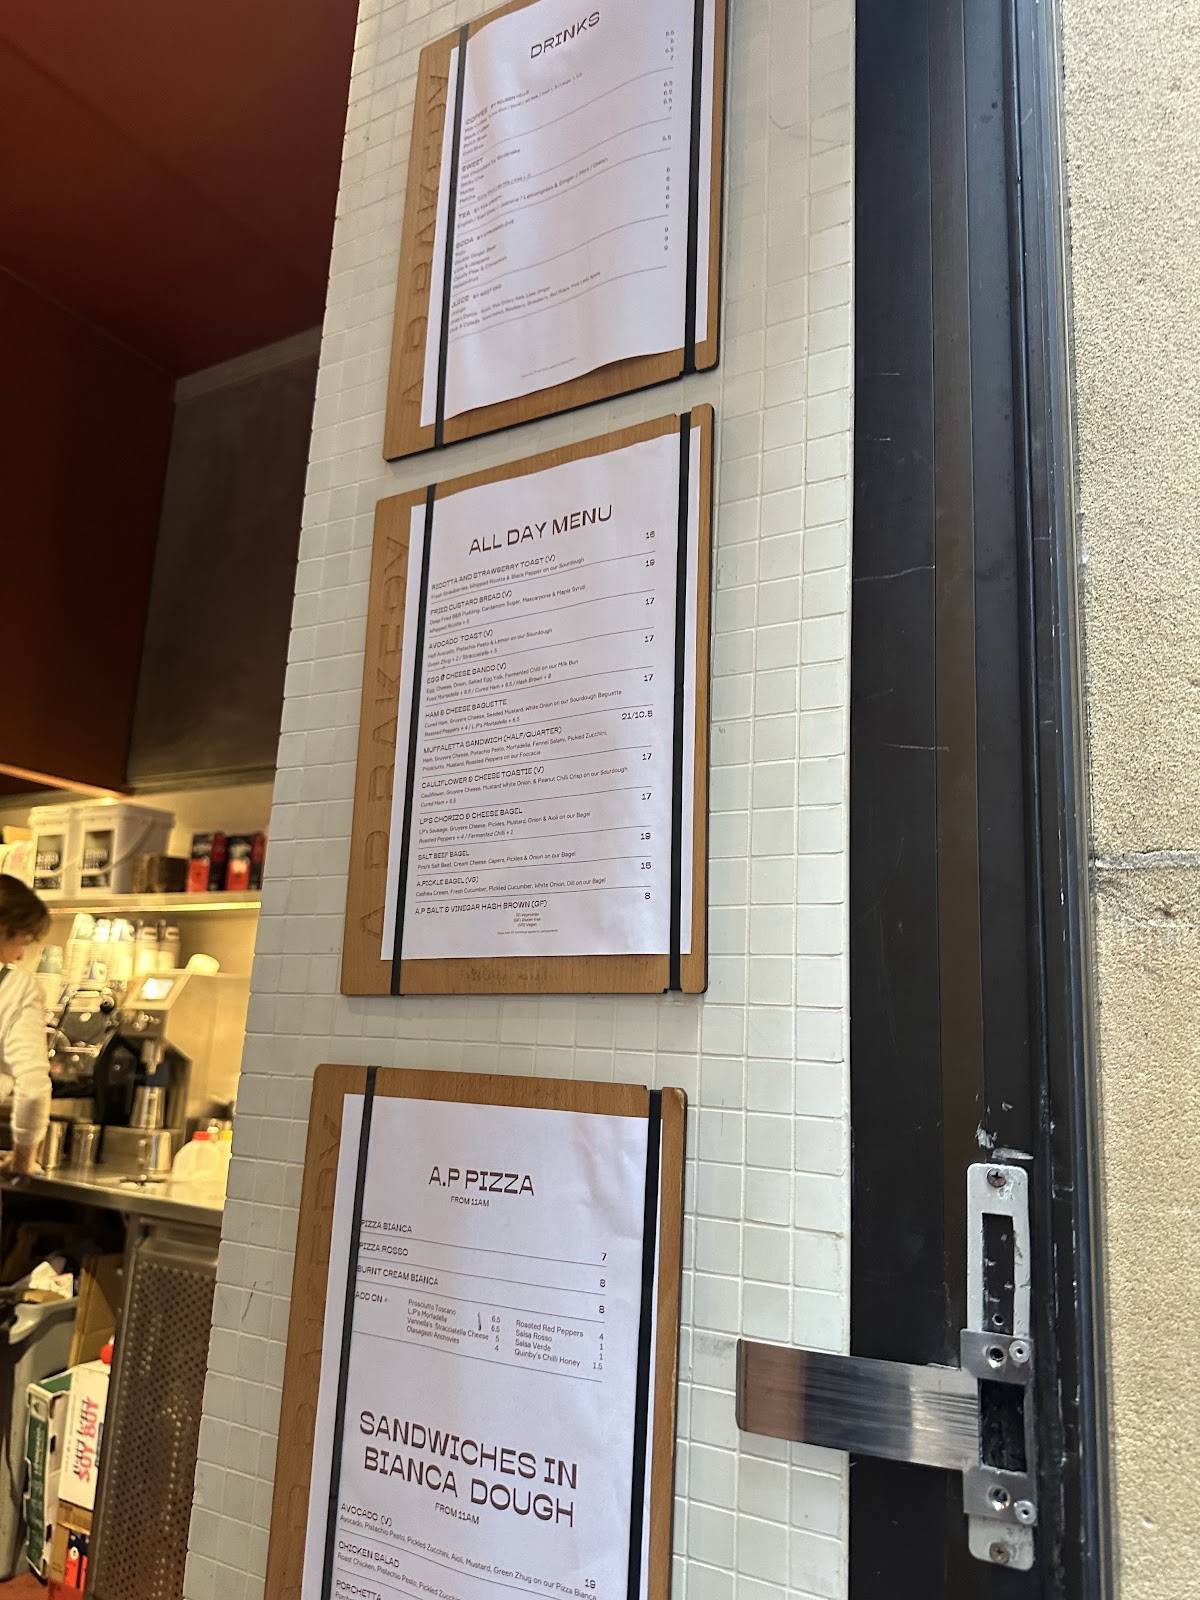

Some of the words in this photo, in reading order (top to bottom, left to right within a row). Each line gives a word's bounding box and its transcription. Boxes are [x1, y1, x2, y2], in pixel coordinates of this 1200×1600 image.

[531, 11, 600, 59] DRINKS
[469, 532, 502, 555] ALL
[507, 520, 546, 546] DAY
[552, 503, 611, 535] MENU
[431, 577, 457, 590] RICOTTA
[458, 573, 472, 582] AND
[472, 561, 518, 578] STRAWBERRY
[520, 556, 543, 568] TOAST
[430, 605, 447, 615] FRIED
[448, 598, 477, 610] CUSTARD
[479, 592, 500, 603] BREAD
[645, 597, 654, 605] 17
[428, 637, 458, 649] AVOCADO
[460, 631, 482, 641] TOAST
[644, 634, 653, 642] 17
[426, 675, 439, 684] EGG
[446, 669, 471, 680] CHEESE
[472, 664, 495, 674] SANDO
[643, 673, 653, 681] 17
[425, 710, 439, 718] HAM
[445, 704, 470, 714] CHEESE
[472, 698, 507, 710] BAGUETTE
[621, 708, 652, 721] 21/10.5
[423, 741, 464, 754] MUFFALETTA
[465, 735, 502, 747] SANDWICH
[642, 752, 651, 760] 17
[421, 776, 467, 788] CAULIFLOWER
[474, 772, 500, 781] CHEESE
[501, 767, 532, 778] TOASTIE
[433, 813, 464, 823] CHORIZO
[471, 809, 498, 819] CHEESE
[499, 806, 522, 815] BAGEL
[450, 904, 479, 912] VINEGAR
[503, 900, 529, 908] BROWN
[429, 1166, 460, 1187] A.P
[465, 1170, 535, 1196] PIZZA
[450, 1196, 470, 1206] FROM
[471, 1198, 490, 1207] 11AM
[360, 1219, 381, 1228] PIZZA
[383, 1222, 412, 1233] BIANCA
[358, 1241, 380, 1252] PIZZA
[381, 1245, 408, 1256] ROSSO
[356, 1264, 381, 1276] BURNT
[382, 1268, 409, 1280] CREAM
[410, 1273, 438, 1285] BIANCA
[600, 1279, 606, 1287] 8
[355, 1291, 370, 1300] ADD
[371, 1294, 382, 1303] ON
[599, 1306, 605, 1314] 8
[359, 1411, 536, 1478] SANDWICHES
[544, 1457, 577, 1489] IN
[364, 1446, 457, 1498] BIANCA
[471, 1478, 574, 1527] DOUGH
[340, 1503, 378, 1521] AVOCADO
[381, 1515, 392, 1527] (V)
[434, 1502, 458, 1518] FROM
[458, 1511, 480, 1524] 11AM
[339, 1541, 373, 1559] CHICKEN
[374, 1552, 400, 1568] SALAD
[494, 1566, 513, 1578] Green
